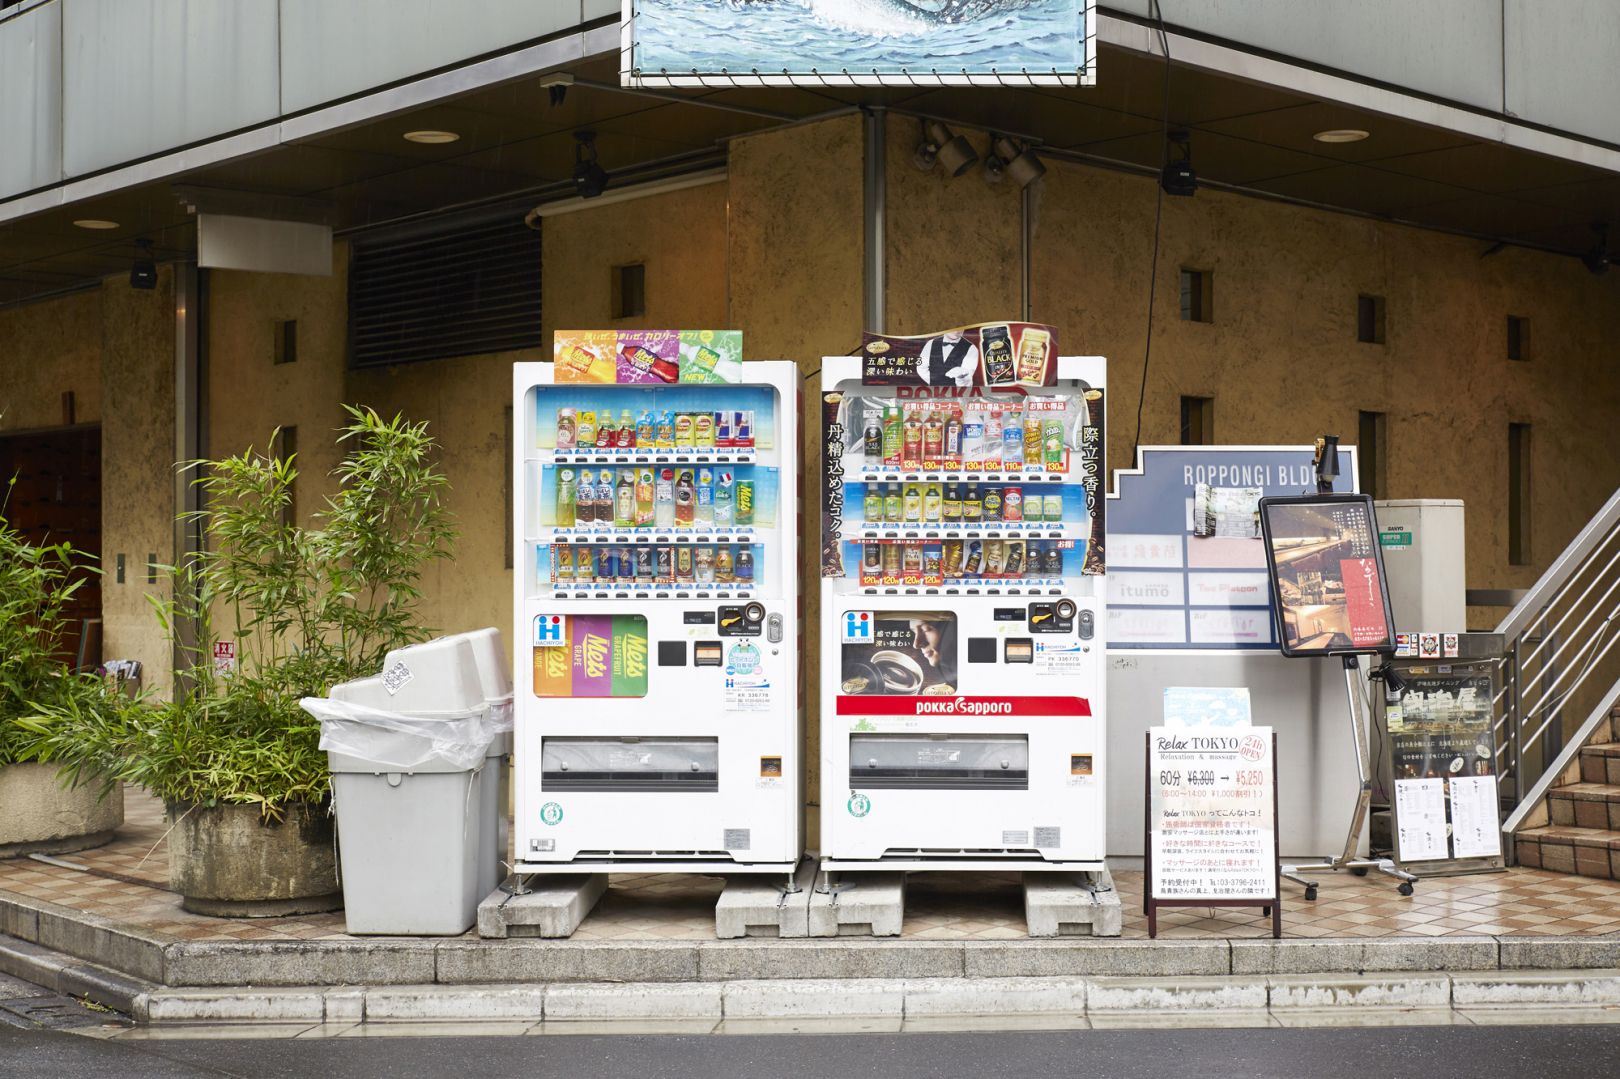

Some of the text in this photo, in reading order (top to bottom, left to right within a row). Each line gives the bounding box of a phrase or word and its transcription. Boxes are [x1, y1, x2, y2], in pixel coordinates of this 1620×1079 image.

[867, 356, 923, 366] 五感で感じる
[987, 355, 1011, 363] BLACK
[866, 367, 913, 376] 深い味わい
[1082, 426, 1099, 517] 際立つ香り。
[1184, 465, 1271, 486] ROPPONGI
[740, 485, 752, 511] Mets
[875, 639, 911, 647] 深い味わい
[574, 645, 582, 667] GRAPE
[587, 633, 609, 678] Mets
[626, 633, 648, 678] Mets
[1157, 734, 1263, 750] Relax TOKYO 24h
[1240, 747, 1262, 760] OPEN
[1160, 770, 1181, 786] 60分
[1235, 770, 1264, 786] ¥5,250
[1163, 808, 1179, 817] Relax
